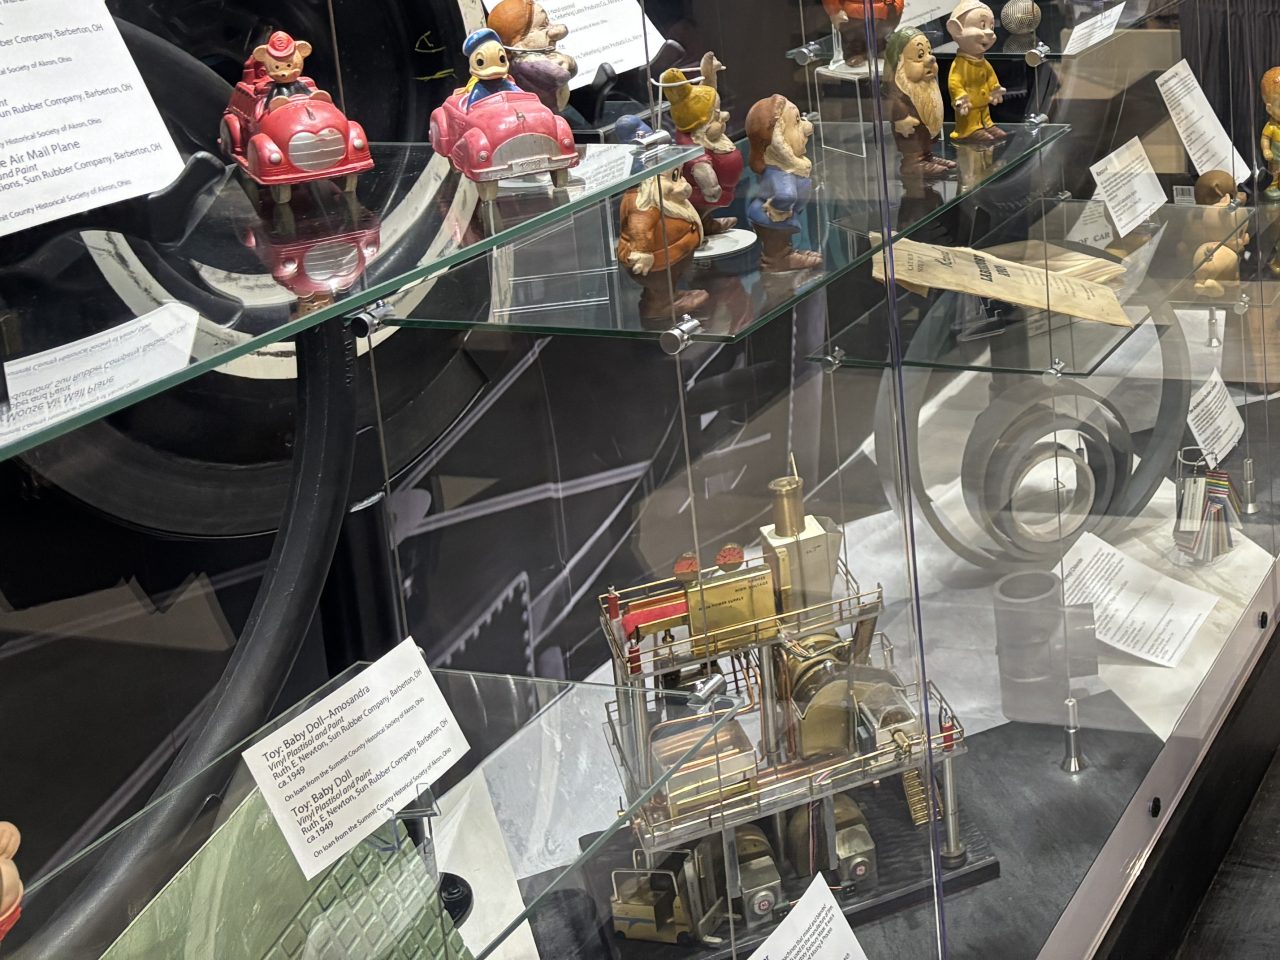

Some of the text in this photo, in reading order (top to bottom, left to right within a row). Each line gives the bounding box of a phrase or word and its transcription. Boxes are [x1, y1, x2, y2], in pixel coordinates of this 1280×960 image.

[0, 23, 104, 47] ber Company, Barberton, OH
[11, 83, 133, 115] Rubber Company, Barberton, OH
[9, 141, 81, 166] Air Mail Plane
[15, 163, 39, 176] Paint
[22, 174, 42, 185] Sun
[41, 165, 73, 179] Rubber
[73, 156, 115, 170] Company,
[113, 147, 152, 160] Barberton,
[150, 142, 162, 152] OH
[261, 746, 284, 762] Toy:
[282, 730, 306, 749] Baby
[267, 716, 345, 772] Vinyl Plastisol and Paint
[272, 765, 292, 781] Ruth
[298, 741, 329, 763] Newton,
[327, 731, 342, 743] Sun
[340, 714, 364, 734] Rubber
[362, 695, 392, 717] Company,
[389, 676, 416, 697] Barberton,
[413, 668, 422, 679] OH
[290, 769, 353, 817] Toy: Baby Doll
[296, 769, 372, 827] Vinyl Plastisol and Paint
[301, 820, 320, 836] Ruth
[326, 794, 357, 817] Newton,
[355, 783, 369, 797] Sun
[368, 766, 391, 786] Rubber
[390, 746, 419, 769] Company,
[416, 726, 442, 748] Barberton,
[439, 717, 449, 728] OH
